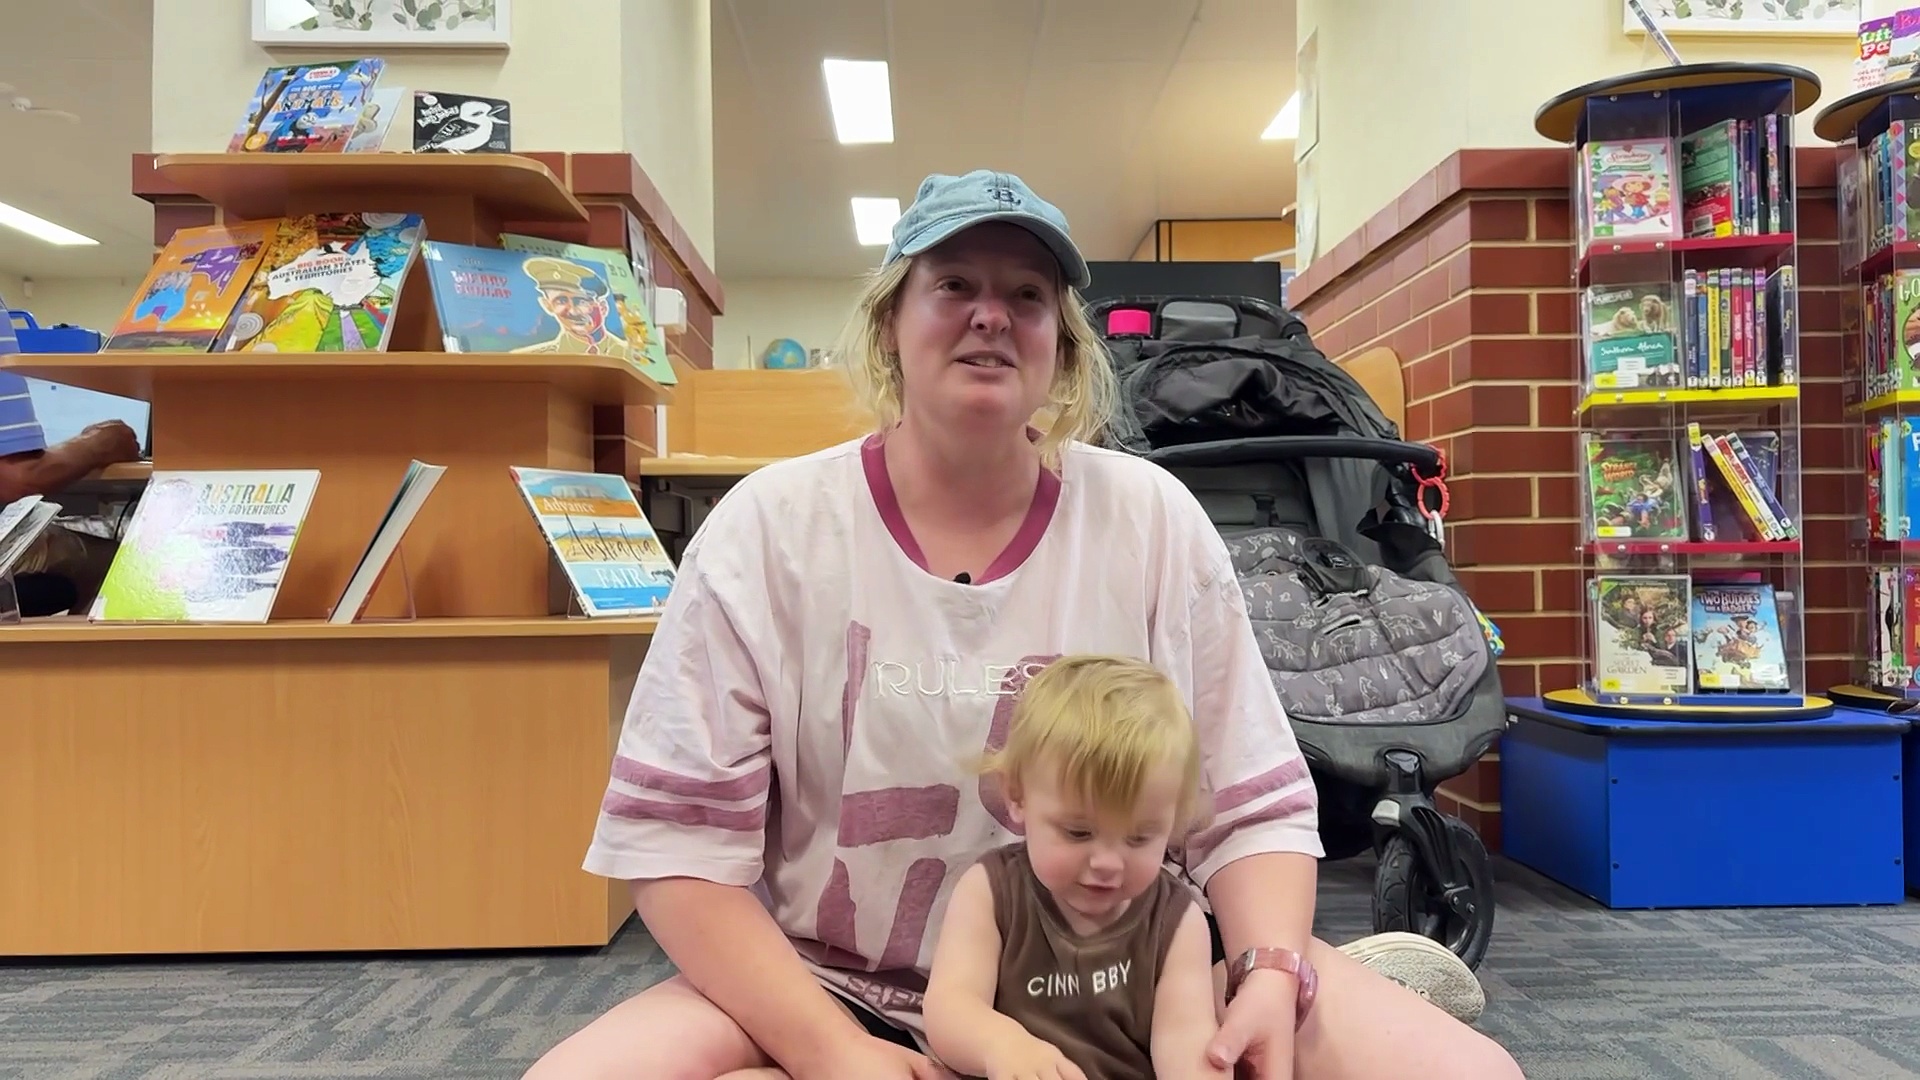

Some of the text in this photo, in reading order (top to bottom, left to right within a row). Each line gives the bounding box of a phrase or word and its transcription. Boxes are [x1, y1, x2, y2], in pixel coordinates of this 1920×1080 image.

[271, 258, 367, 280] AUSTRALIAN STATES
[294, 267, 353, 281] TERRITORIES
[196, 483, 297, 504] AUSTRALIA
[543, 497, 596, 513] Advance
[555, 513, 656, 562] Australia
[595, 567, 647, 589] FAIR
[1700, 591, 1761, 605] TWO BUDDIES
[1027, 959, 1132, 998] CINN BBY
